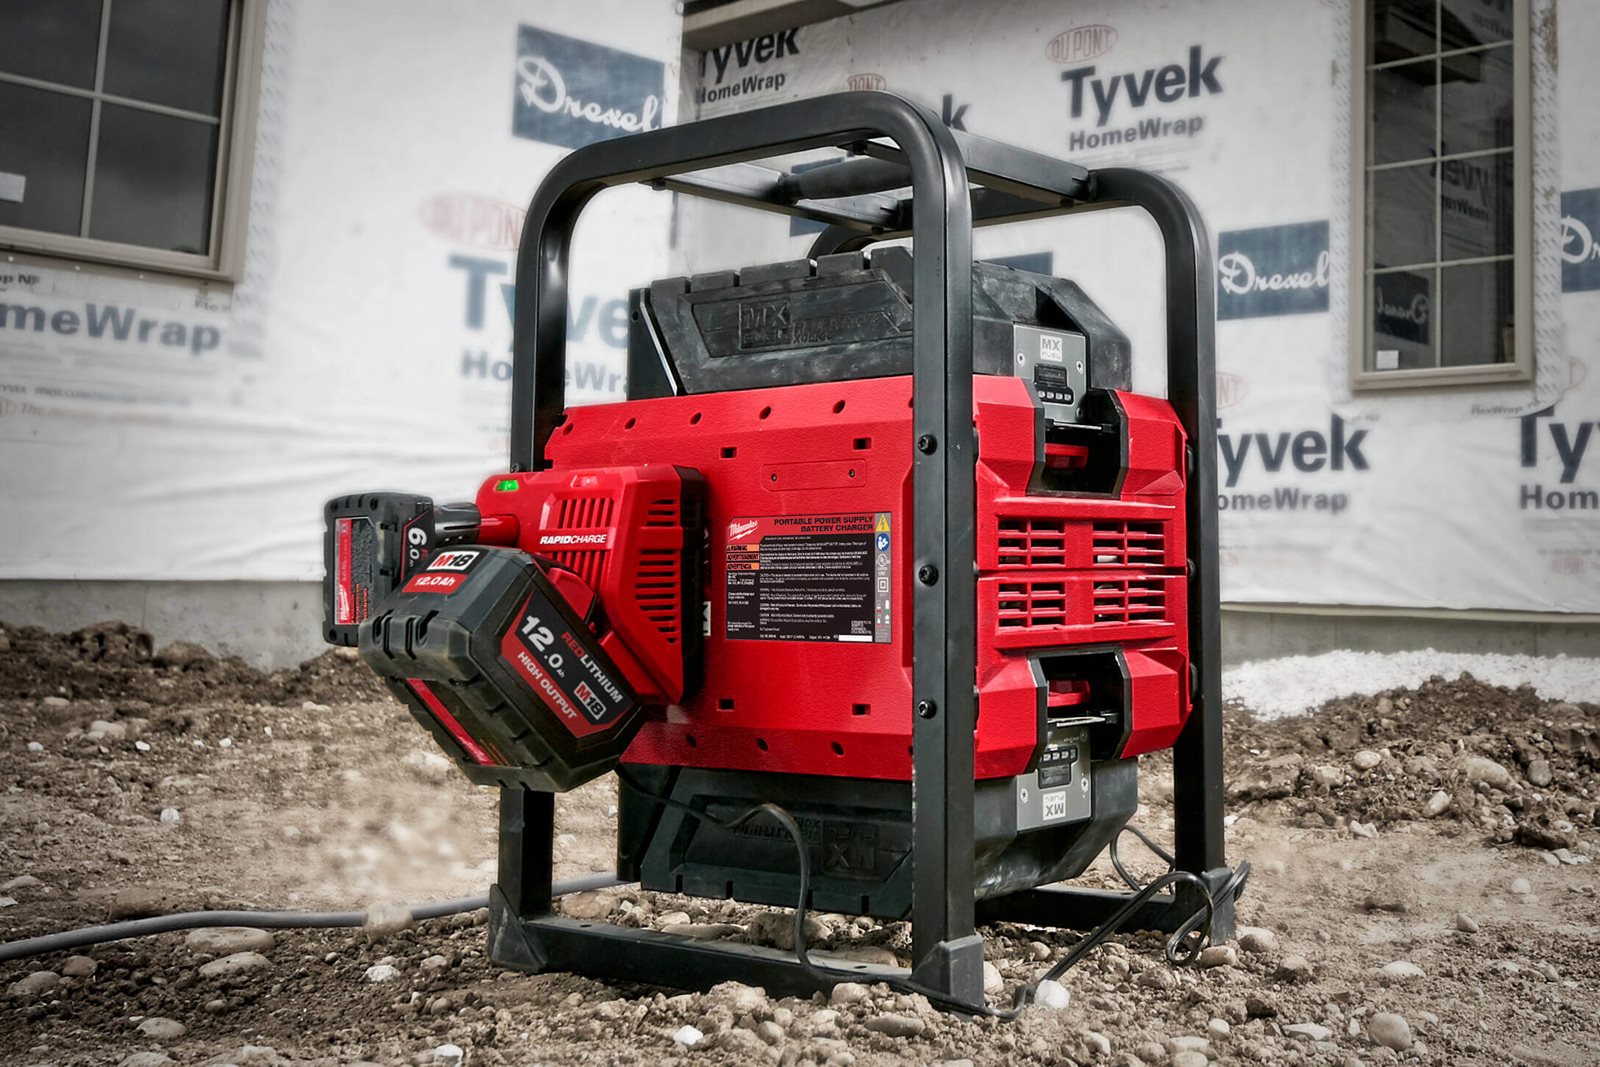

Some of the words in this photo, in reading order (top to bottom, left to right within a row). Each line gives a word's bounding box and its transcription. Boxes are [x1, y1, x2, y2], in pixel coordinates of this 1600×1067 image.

[516, 56, 662, 133] Drexel
[696, 73, 787, 104] HomeWrap
[1061, 45, 1224, 127] Tyvek
[1068, 113, 1205, 152] HomeWrap
[1218, 250, 1332, 295] Drexel
[1041, 338, 1060, 352] MX
[1217, 413, 1370, 488] yvek
[1217, 487, 1349, 515] omeWrap
[774, 517, 812, 526] PORTABLE
[813, 516, 841, 525] POWER
[843, 515, 873, 524] SUPPLY
[801, 525, 834, 533] BATTERY
[835, 523, 873, 532] CHARGER
[431, 553, 474, 568] M18
[517, 651, 543, 680] HIGH
[540, 678, 577, 719] OUTPUT
[575, 683, 606, 718] M18
[1045, 803, 1065, 818] MX
